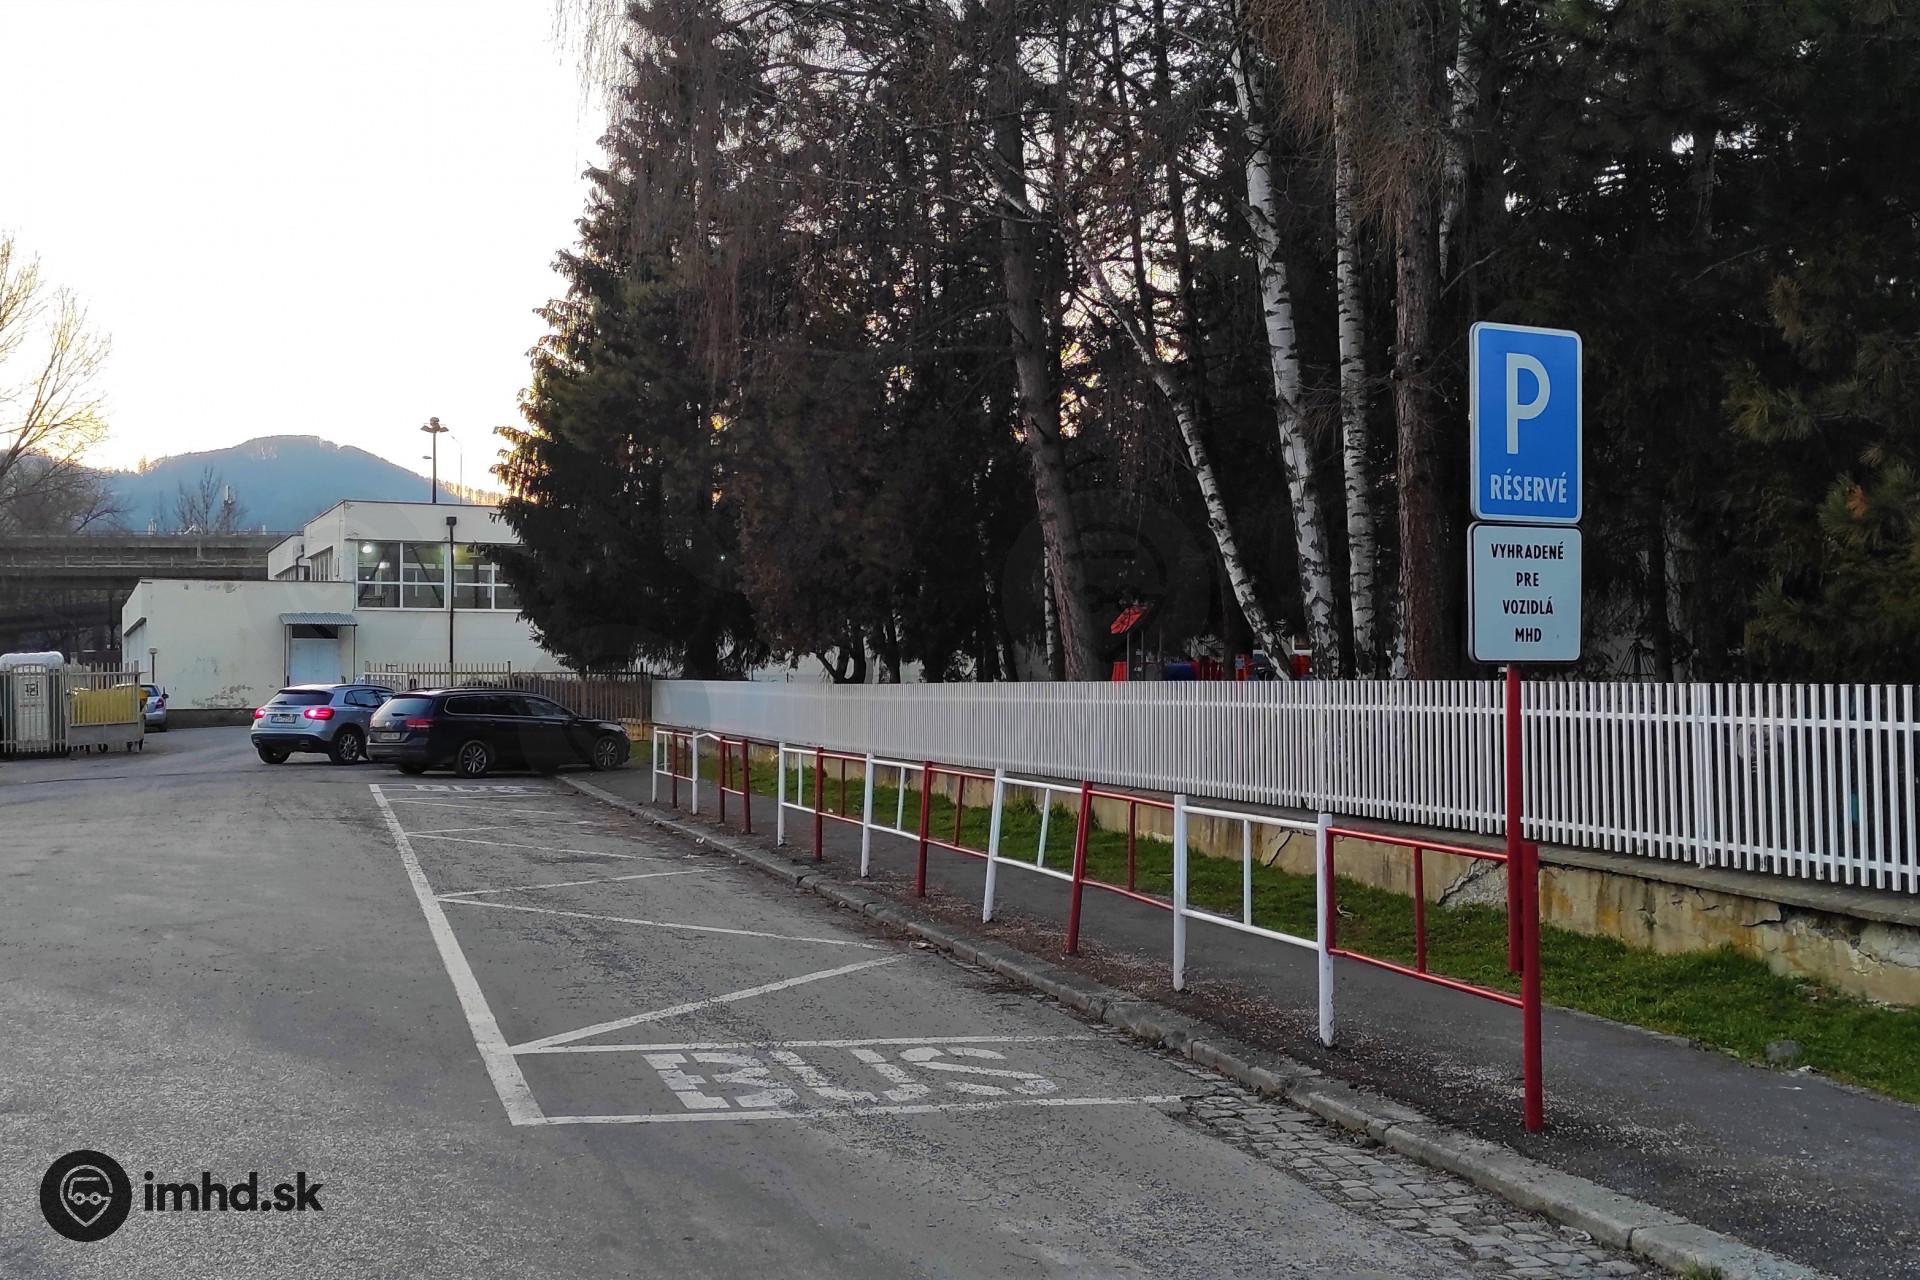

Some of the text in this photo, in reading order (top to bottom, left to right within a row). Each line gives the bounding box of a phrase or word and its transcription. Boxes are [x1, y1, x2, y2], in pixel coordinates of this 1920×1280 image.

[1506, 352, 1551, 454] P
[1490, 468, 1568, 503] RÉSERVÉ
[1490, 541, 1564, 560] VYHRADENÉ
[1516, 571, 1540, 587] PRE
[1502, 596, 1554, 615] VOZIDLÁ
[1514, 626, 1542, 643] MHD
[641, 1046, 1060, 1110] BUS
